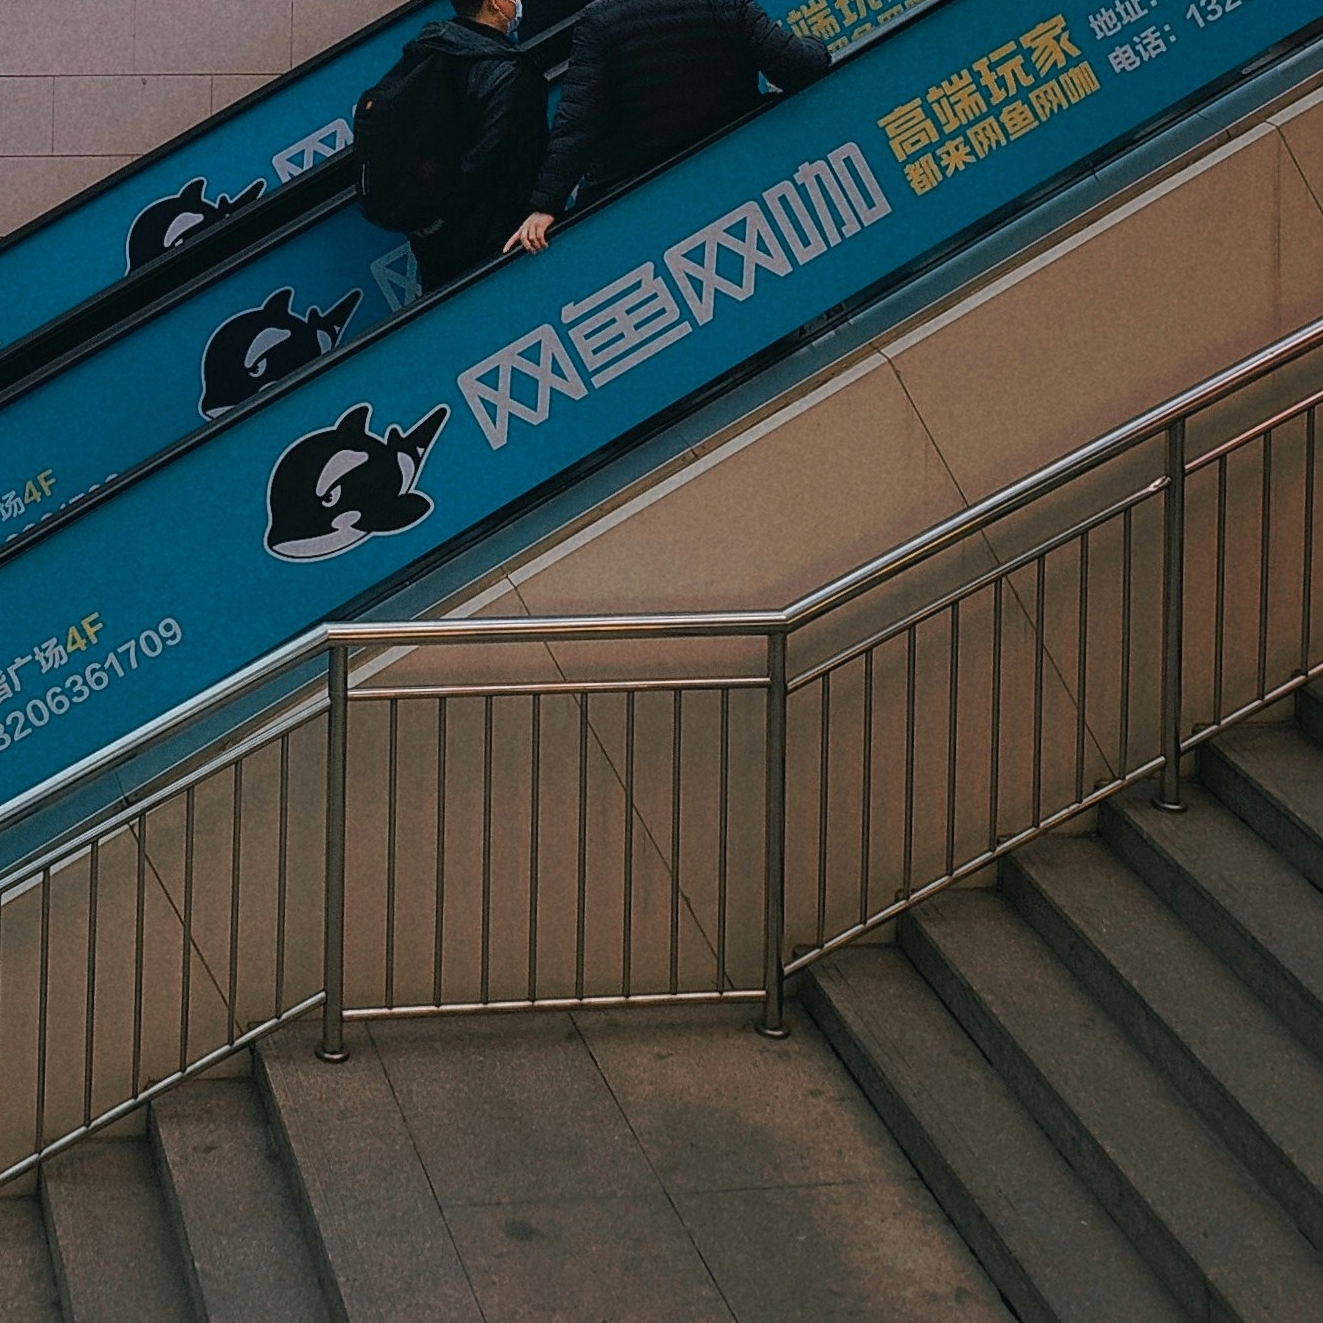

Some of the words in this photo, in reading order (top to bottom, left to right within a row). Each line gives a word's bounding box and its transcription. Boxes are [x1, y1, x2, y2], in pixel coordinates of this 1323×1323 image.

[457, 141, 892, 451] 网鱼网咖
[877, 13, 1083, 162] 高端玩家
[903, 59, 1102, 197] 都来网鱼网咖
